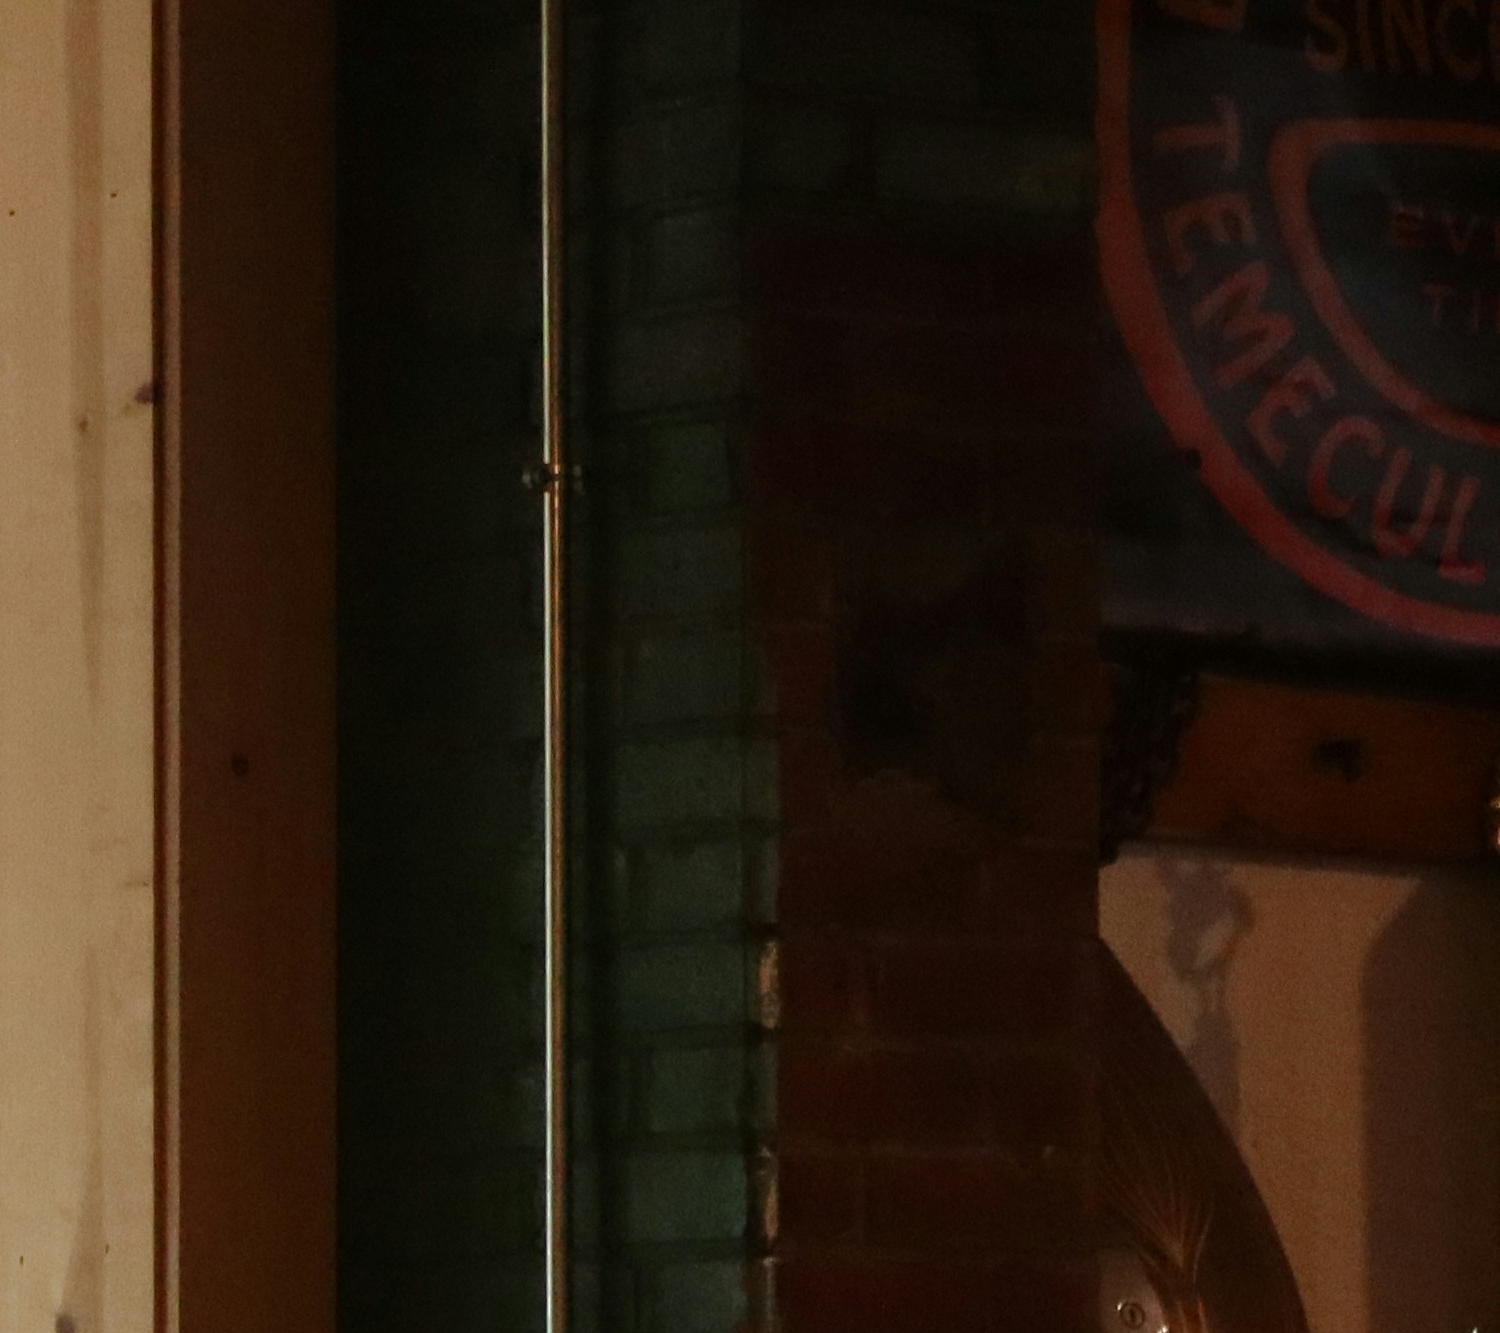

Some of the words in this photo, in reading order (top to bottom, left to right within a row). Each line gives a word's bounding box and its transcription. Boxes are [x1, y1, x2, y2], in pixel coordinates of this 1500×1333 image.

[1304, 0, 1500, 80] SINC
[1387, 203, 1500, 262] EV
[1150, 95, 1487, 586] TEMECUL
[1421, 282, 1500, 336] TI
